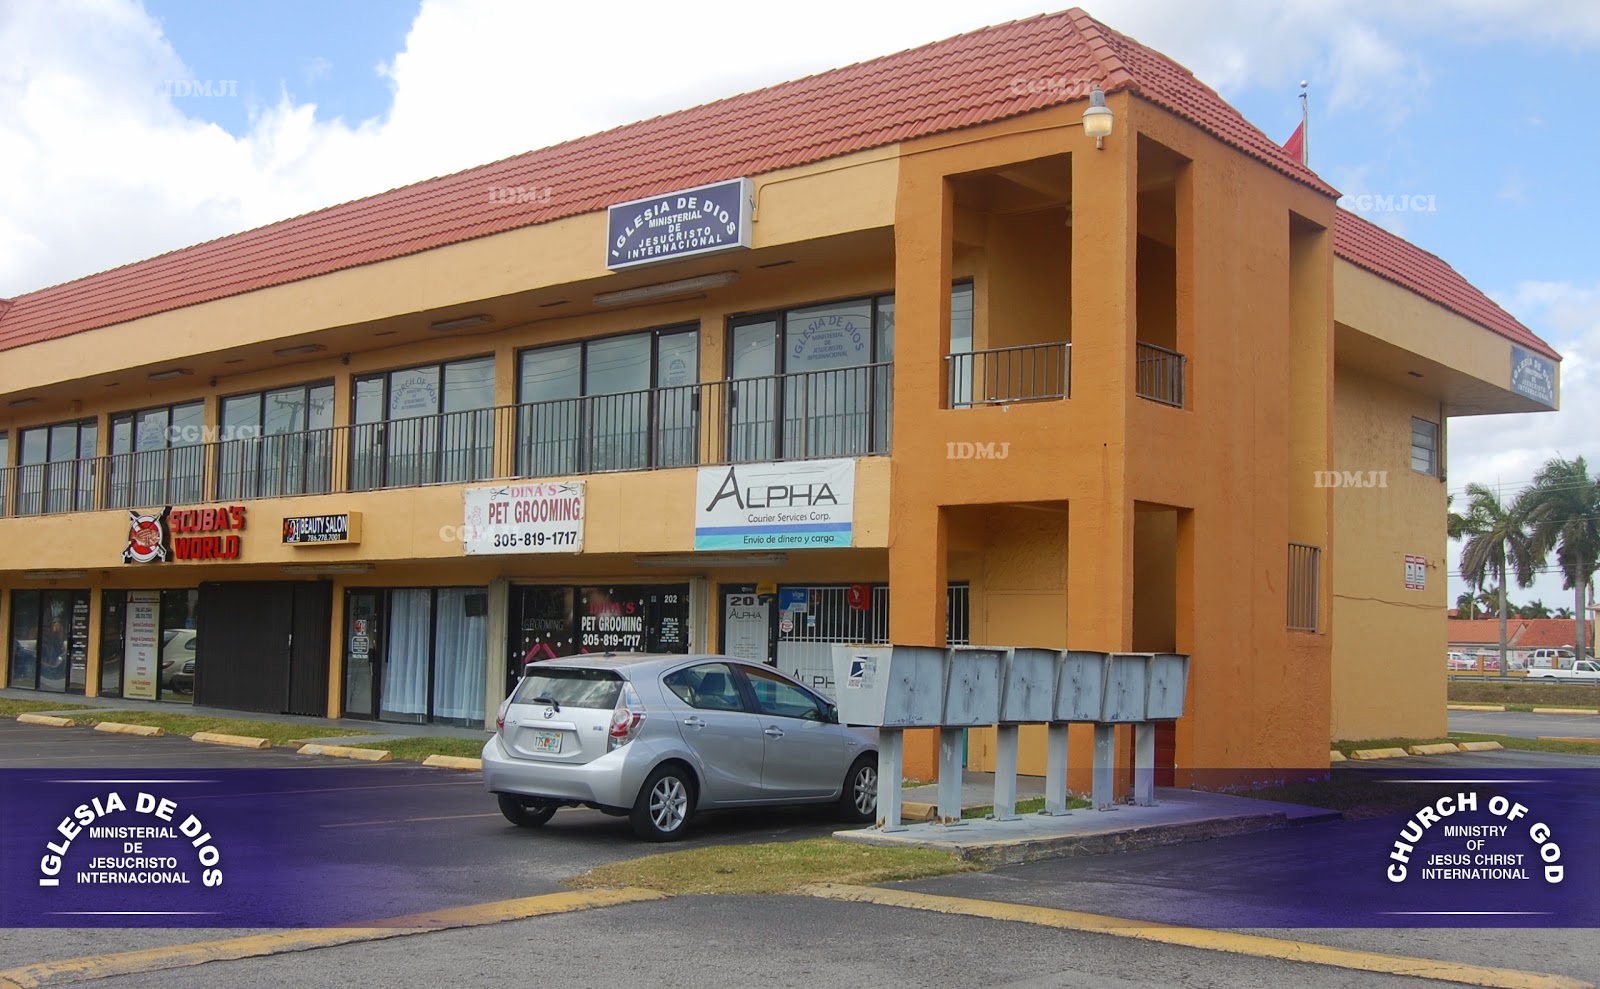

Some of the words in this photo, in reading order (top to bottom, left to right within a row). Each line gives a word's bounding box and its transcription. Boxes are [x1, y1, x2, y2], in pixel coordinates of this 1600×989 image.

[612, 201, 670, 257] IGLESIA
[677, 197, 697, 209] DE
[703, 200, 736, 236] DIOS
[649, 210, 702, 228] MINISTERIAL
[668, 223, 681, 233] DE
[639, 226, 711, 248] JESUCRISTO
[628, 234, 722, 259] INTERNACIONAL
[792, 318, 826, 359] IGLESIA
[829, 316, 844, 327] DE
[844, 321, 864, 351] DIOS
[392, 378, 415, 410] CHURCH
[416, 377, 426, 385] OF
[427, 384, 437, 404] GOD
[705, 466, 838, 512] ALPHA
[170, 506, 246, 533] SCUBA'S
[488, 502, 509, 525] PET
[514, 497, 580, 523] GROOMING
[747, 513, 775, 523] Courier
[778, 512, 807, 522] Services
[810, 511, 831, 523] Corp.
[300, 517, 324, 534] BEAUTY
[325, 516, 347, 533] SALON
[174, 535, 240, 560] WORLD
[494, 531, 577, 547] 305-819-1717
[766, 535, 776, 543] de
[778, 534, 802, 543] dinero
[804, 536, 810, 544] y
[811, 535, 834, 544] carga
[664, 595, 678, 603] 202
[729, 607, 762, 619] ALPHA
[581, 616, 595, 632] PET
[598, 616, 642, 632] GROOMING
[583, 634, 640, 647] 305-819-1717
